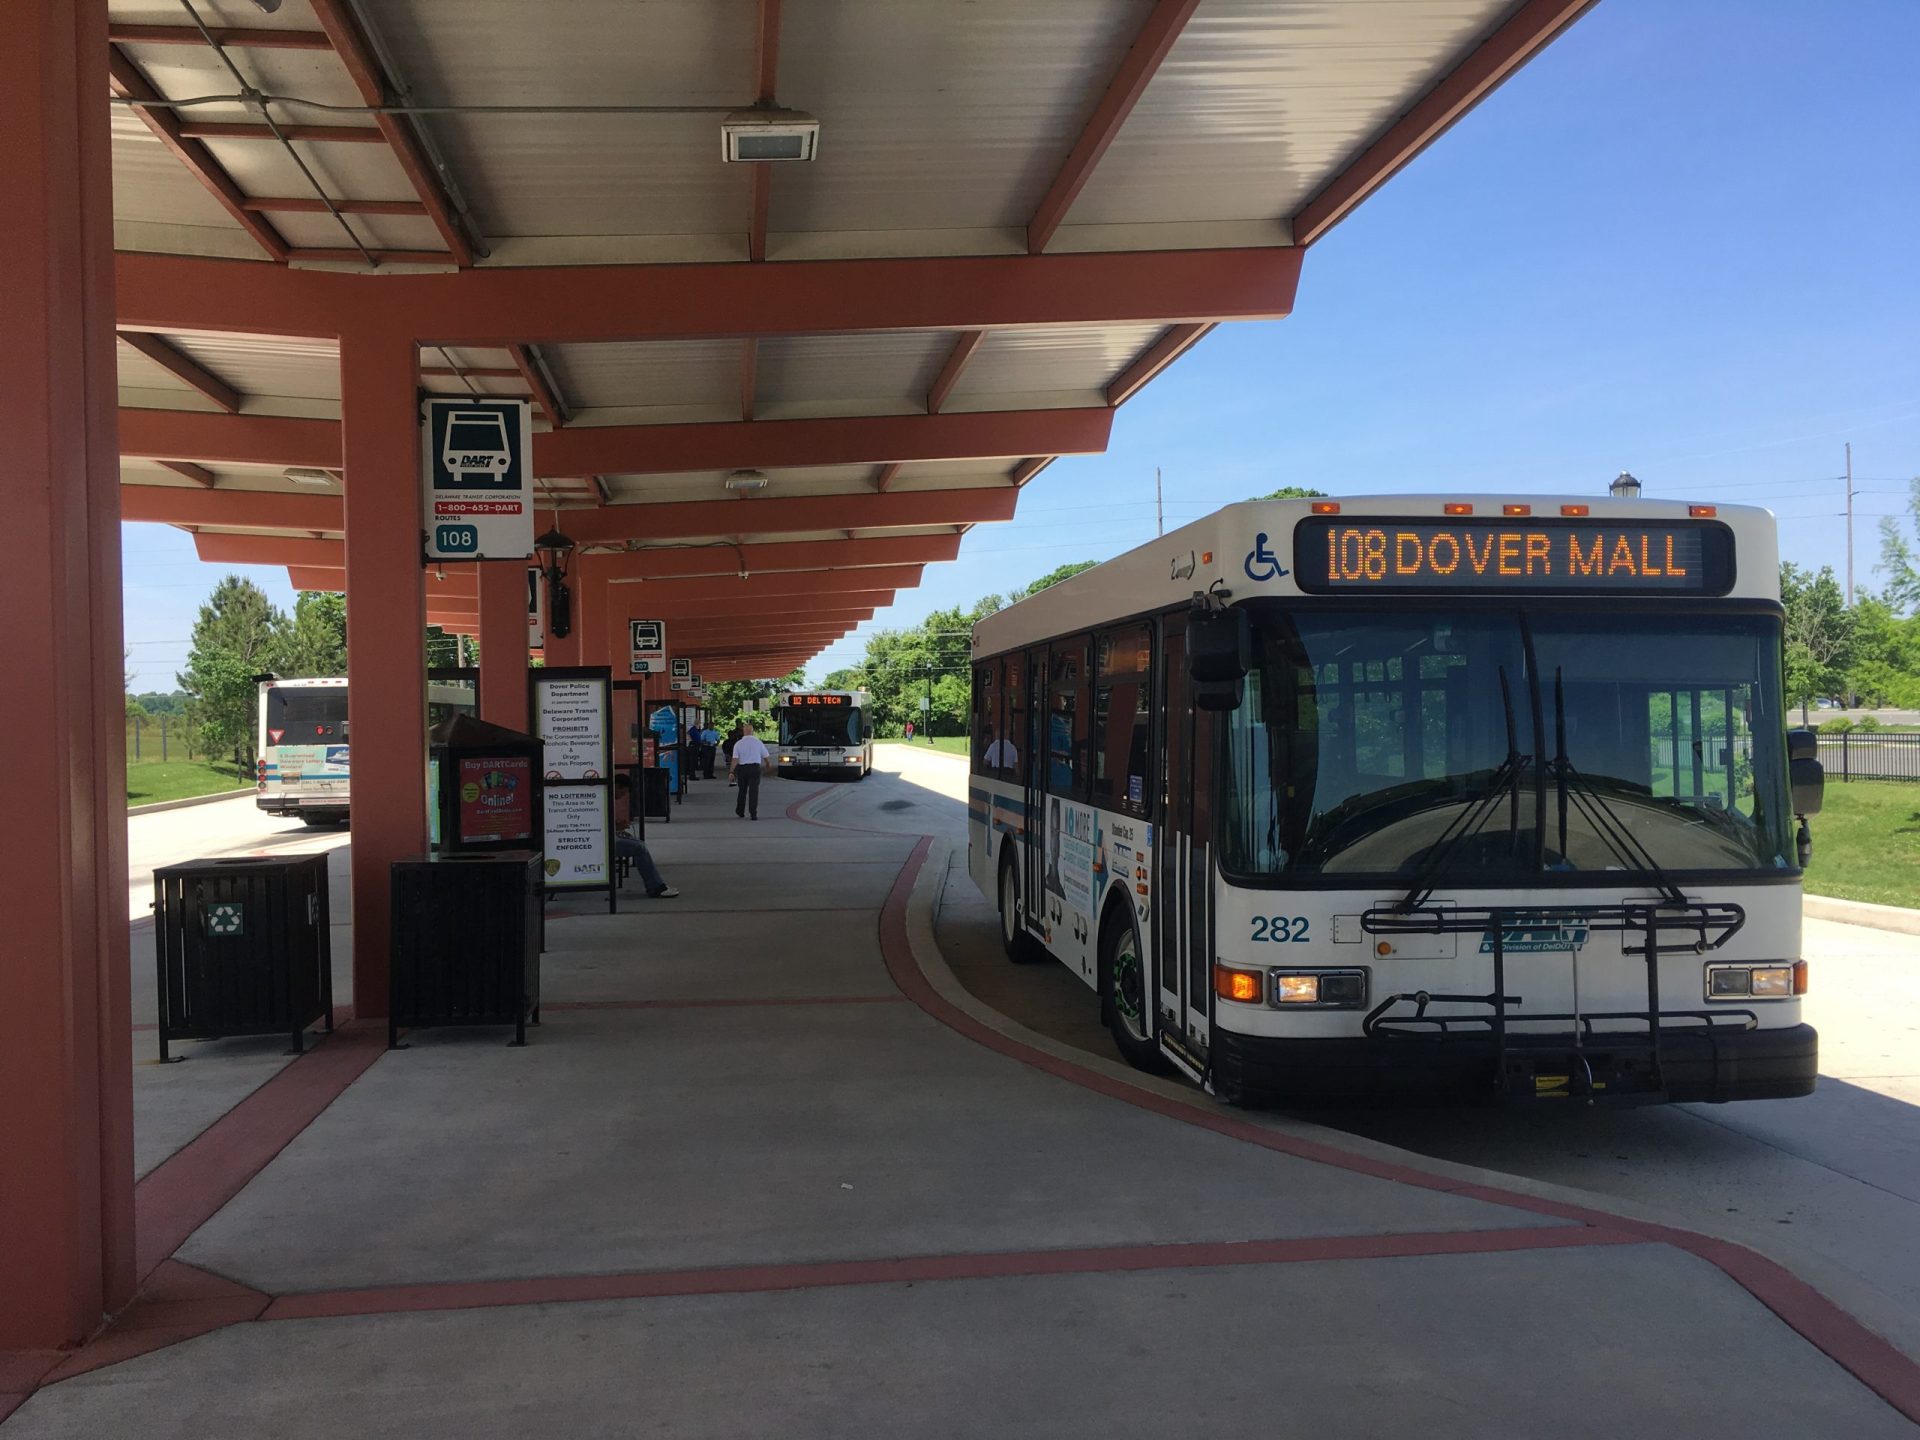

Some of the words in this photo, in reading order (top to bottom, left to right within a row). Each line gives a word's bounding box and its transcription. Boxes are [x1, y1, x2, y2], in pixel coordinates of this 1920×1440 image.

[460, 455, 494, 468] DART
[438, 504, 519, 512] 1-800-652-DART
[442, 531, 472, 547] 108
[1328, 529, 1387, 579] 108
[1396, 533, 1551, 575] DOVER
[1569, 534, 1686, 576] MALL
[464, 761, 480, 770] Buy
[480, 793, 514, 806] Online!
[1251, 915, 1310, 943] 282
